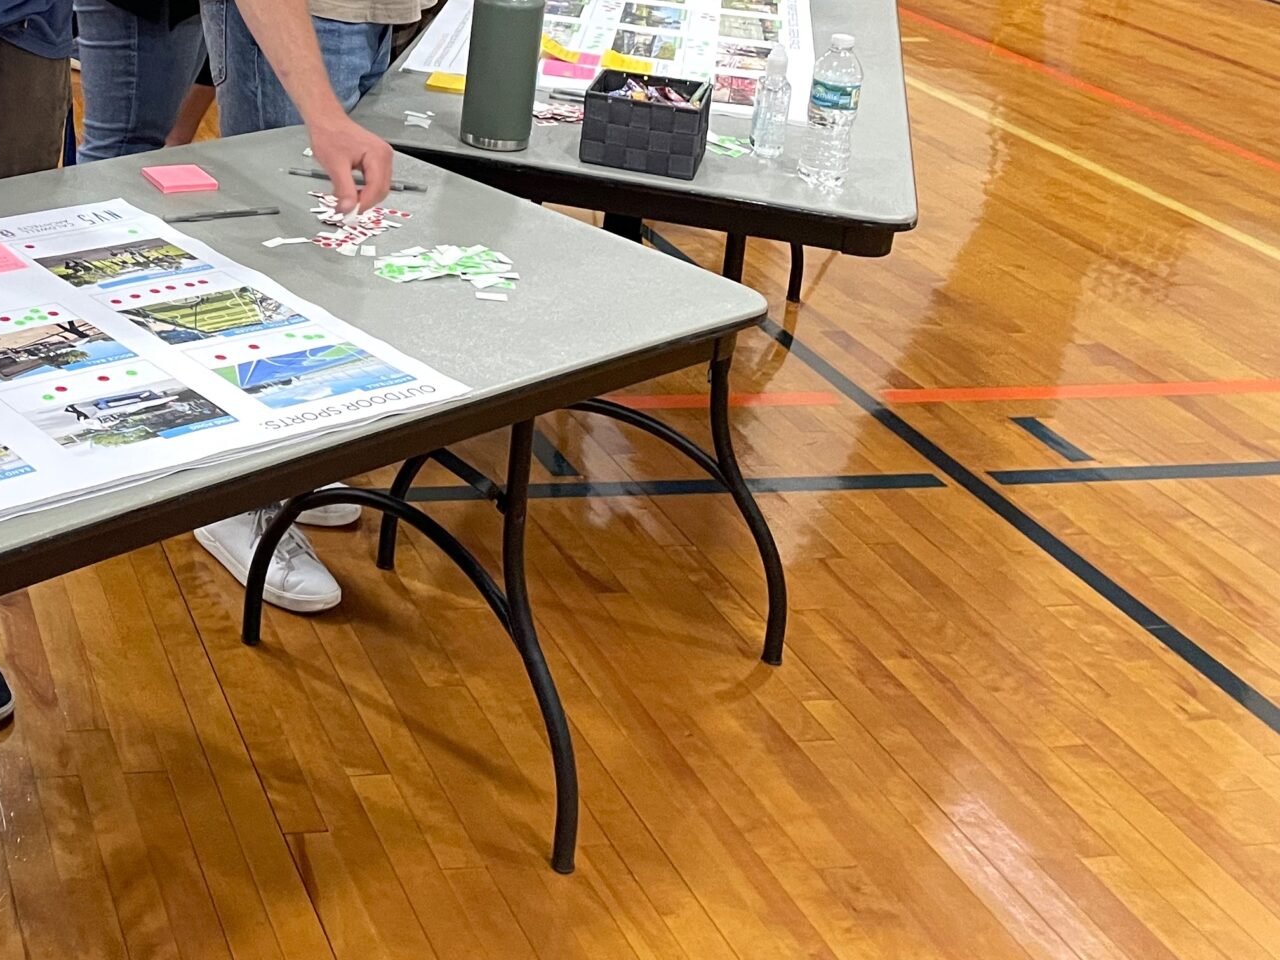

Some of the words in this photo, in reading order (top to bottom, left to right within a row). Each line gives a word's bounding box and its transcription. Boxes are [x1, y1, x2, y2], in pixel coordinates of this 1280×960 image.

[77, 209, 124, 227] NV5
[345, 384, 437, 412] OUTDOOR
[259, 406, 342, 430] SPORTS:
[5, 467, 32, 477] SAND
